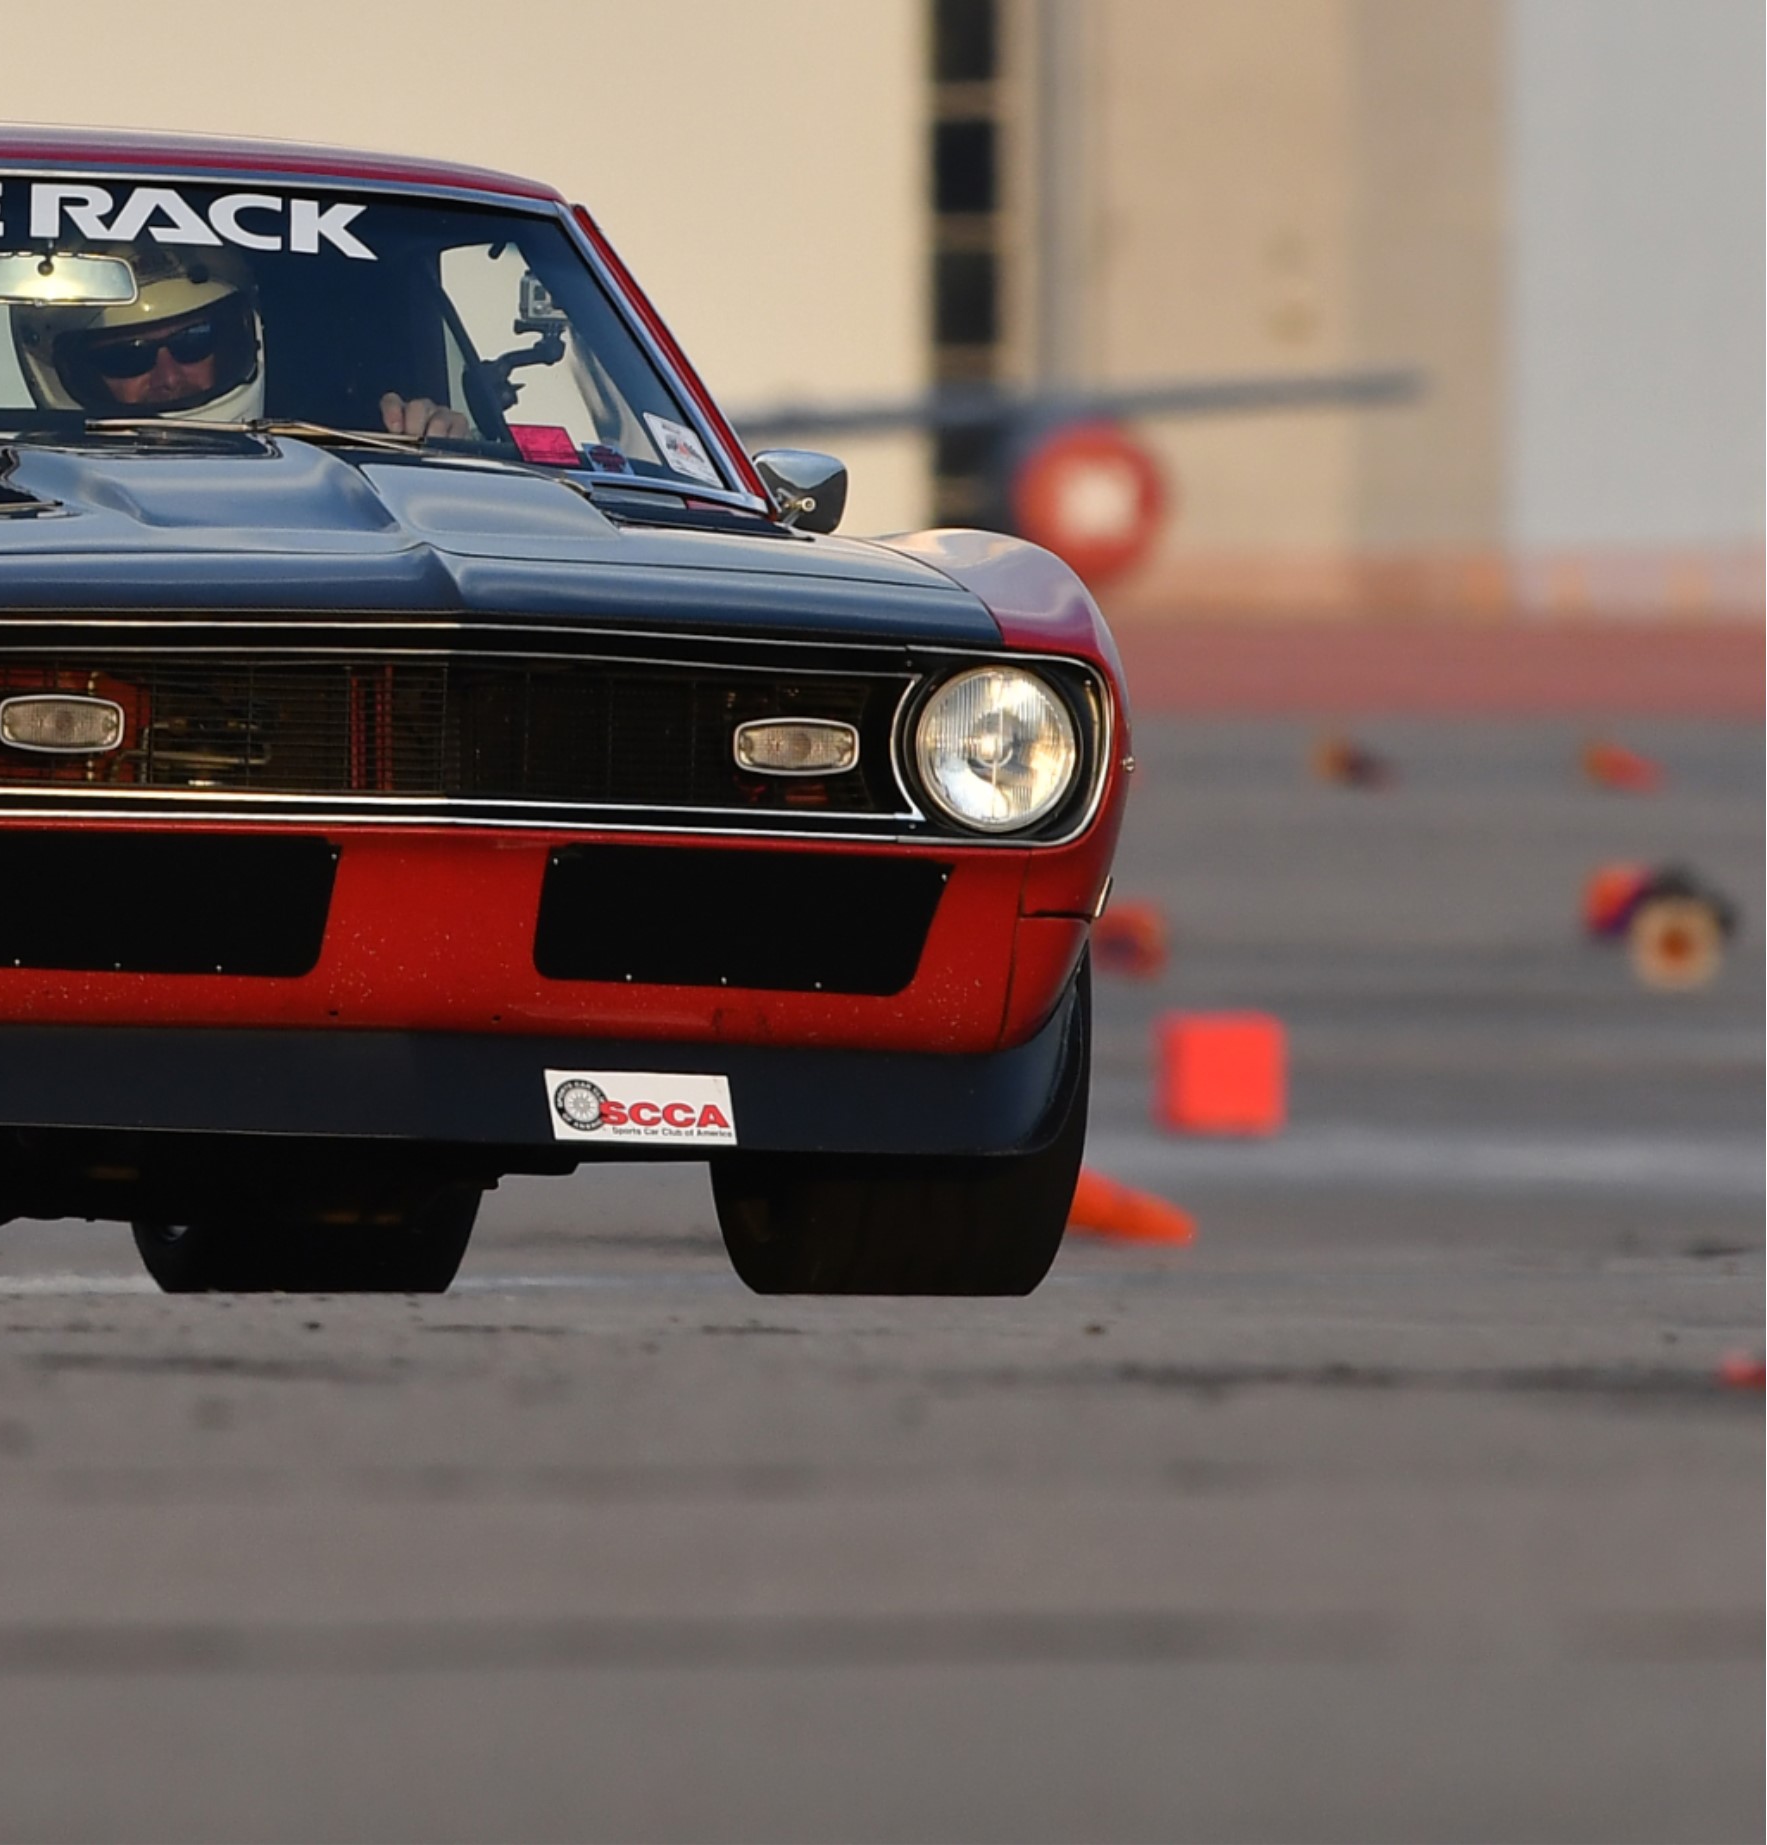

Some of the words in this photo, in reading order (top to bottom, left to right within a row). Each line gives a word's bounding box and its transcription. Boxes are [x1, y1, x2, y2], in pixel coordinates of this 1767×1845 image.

[30, 182, 379, 260] RACK
[599, 1100, 731, 1128] SCCA
[612, 1126, 642, 1136] Sports
[644, 1127, 659, 1136] Car
[662, 1128, 684, 1137] Club
[685, 1128, 695, 1137] of
[697, 1129, 733, 1138] America
